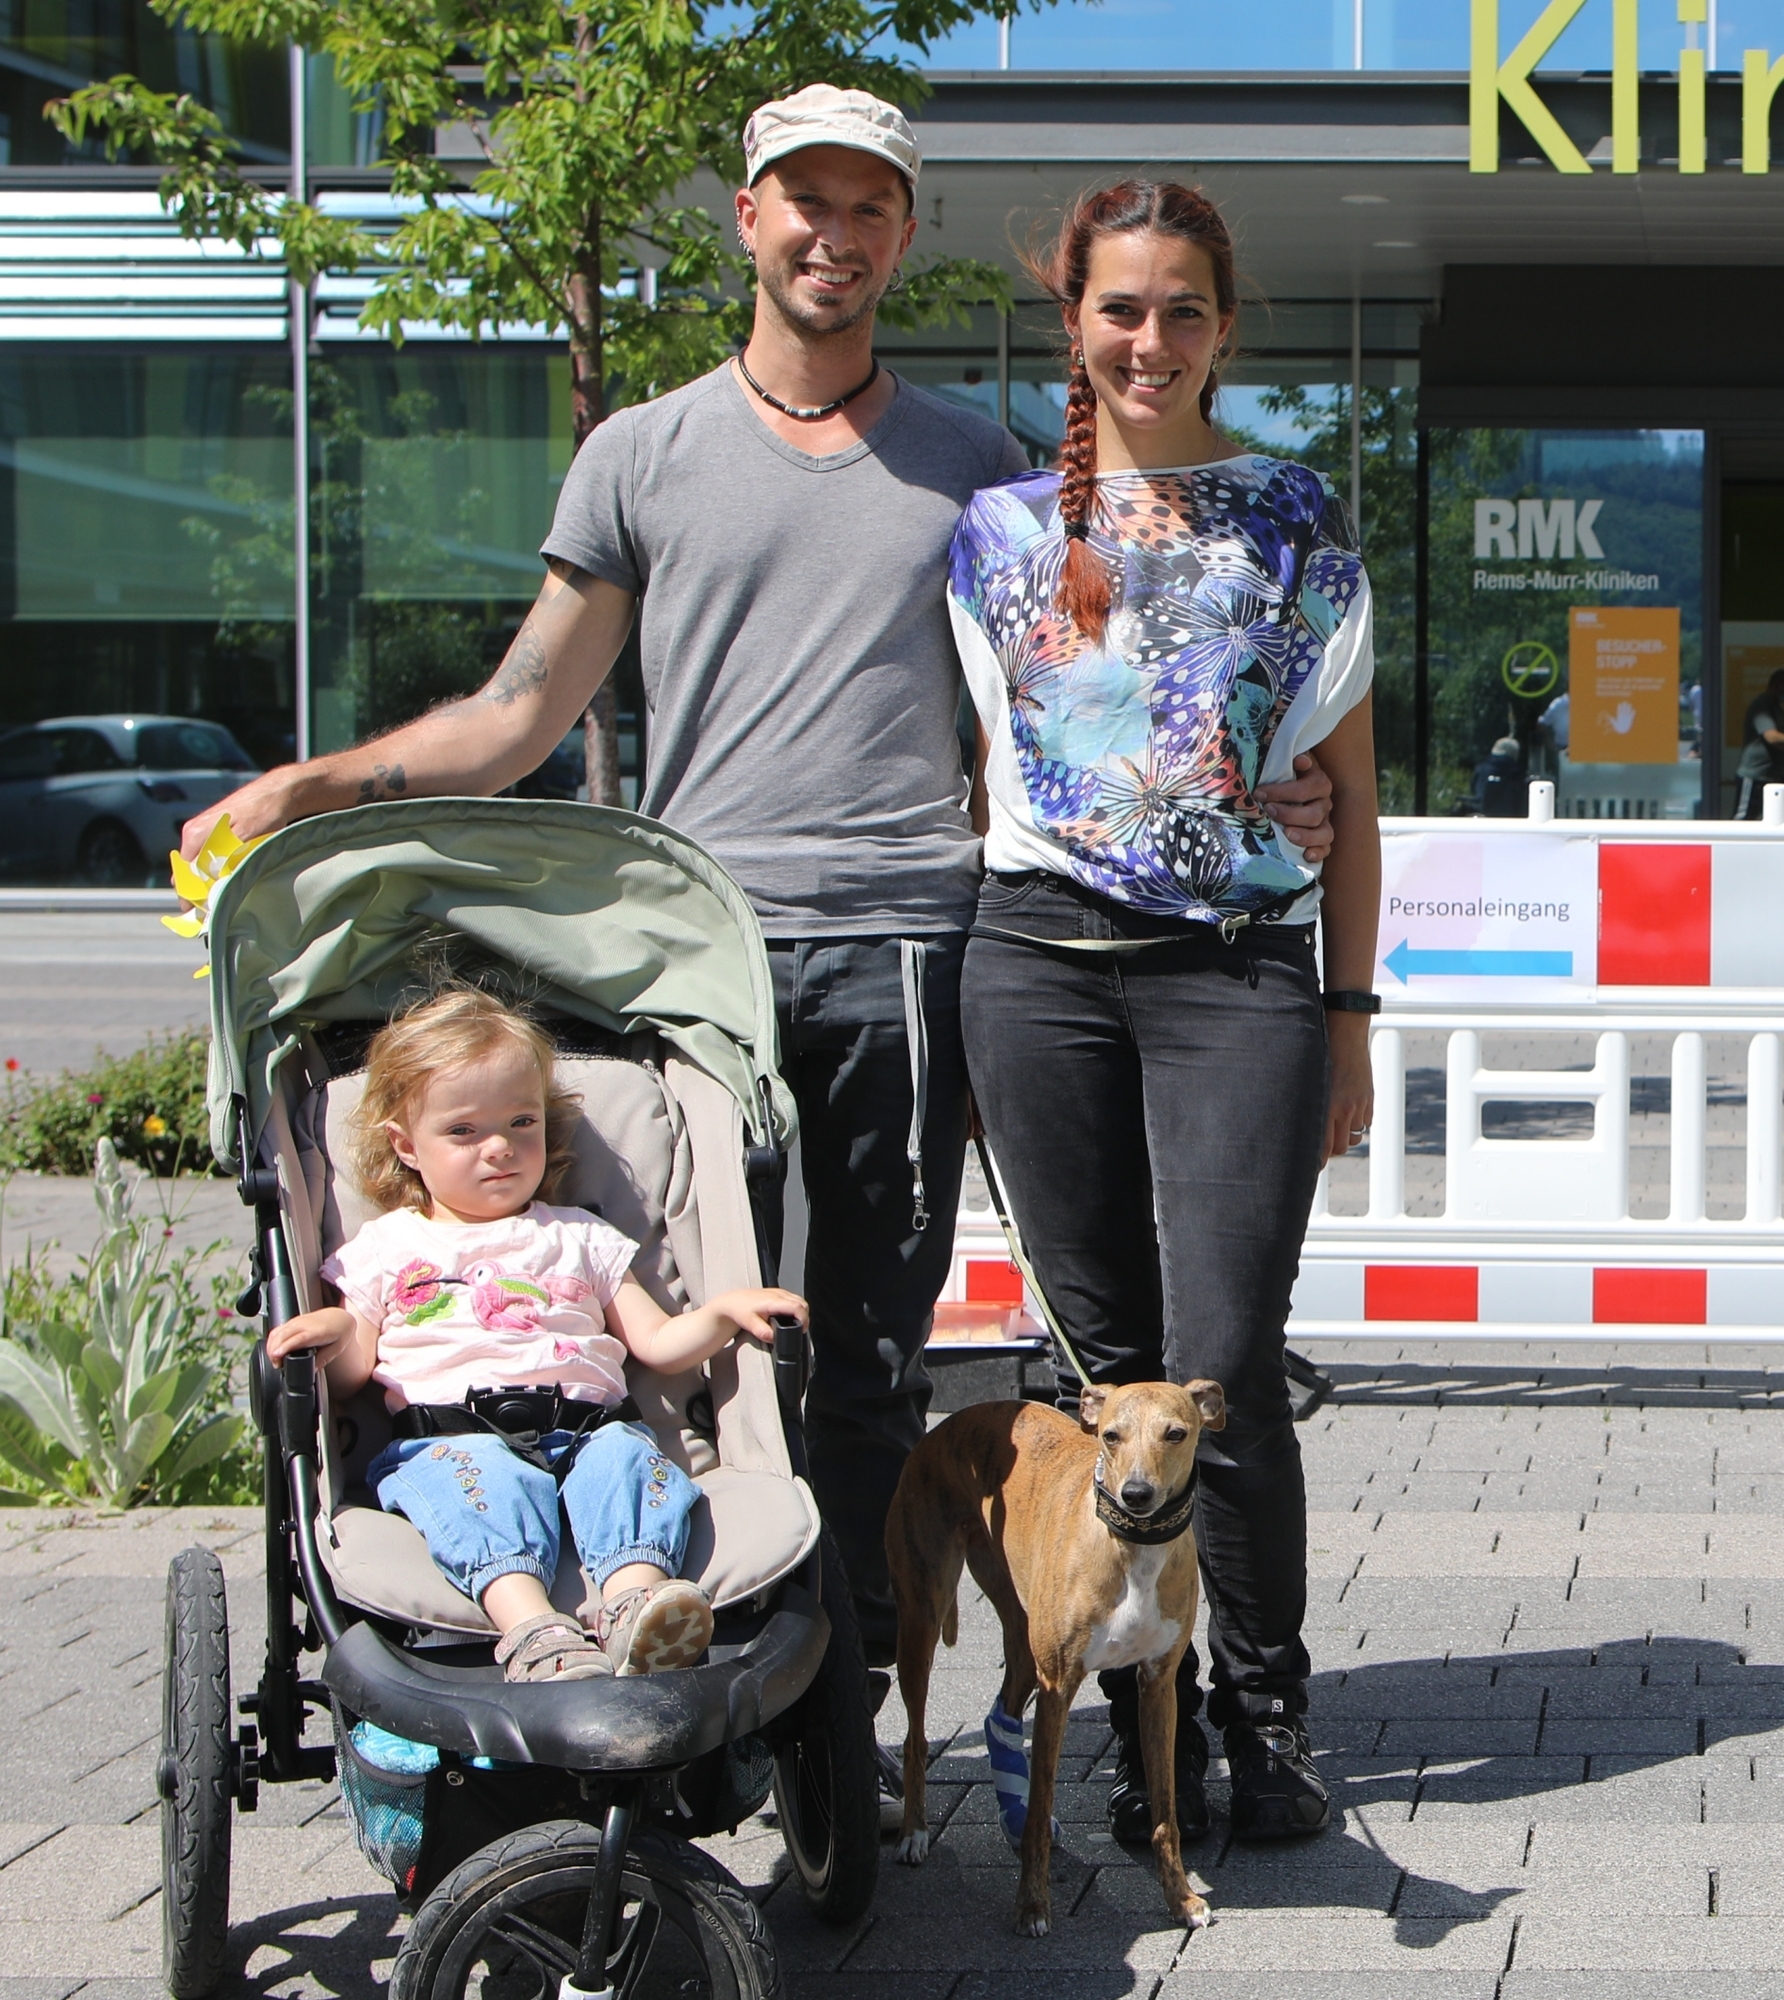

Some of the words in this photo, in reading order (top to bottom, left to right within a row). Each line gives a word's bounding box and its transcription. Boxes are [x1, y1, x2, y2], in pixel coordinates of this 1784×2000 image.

[1474, 499, 1605, 558] RMK
[1473, 570, 1659, 590] Rems-Murr-Kliniken
[1389, 896, 1570, 922] Personaleingang
